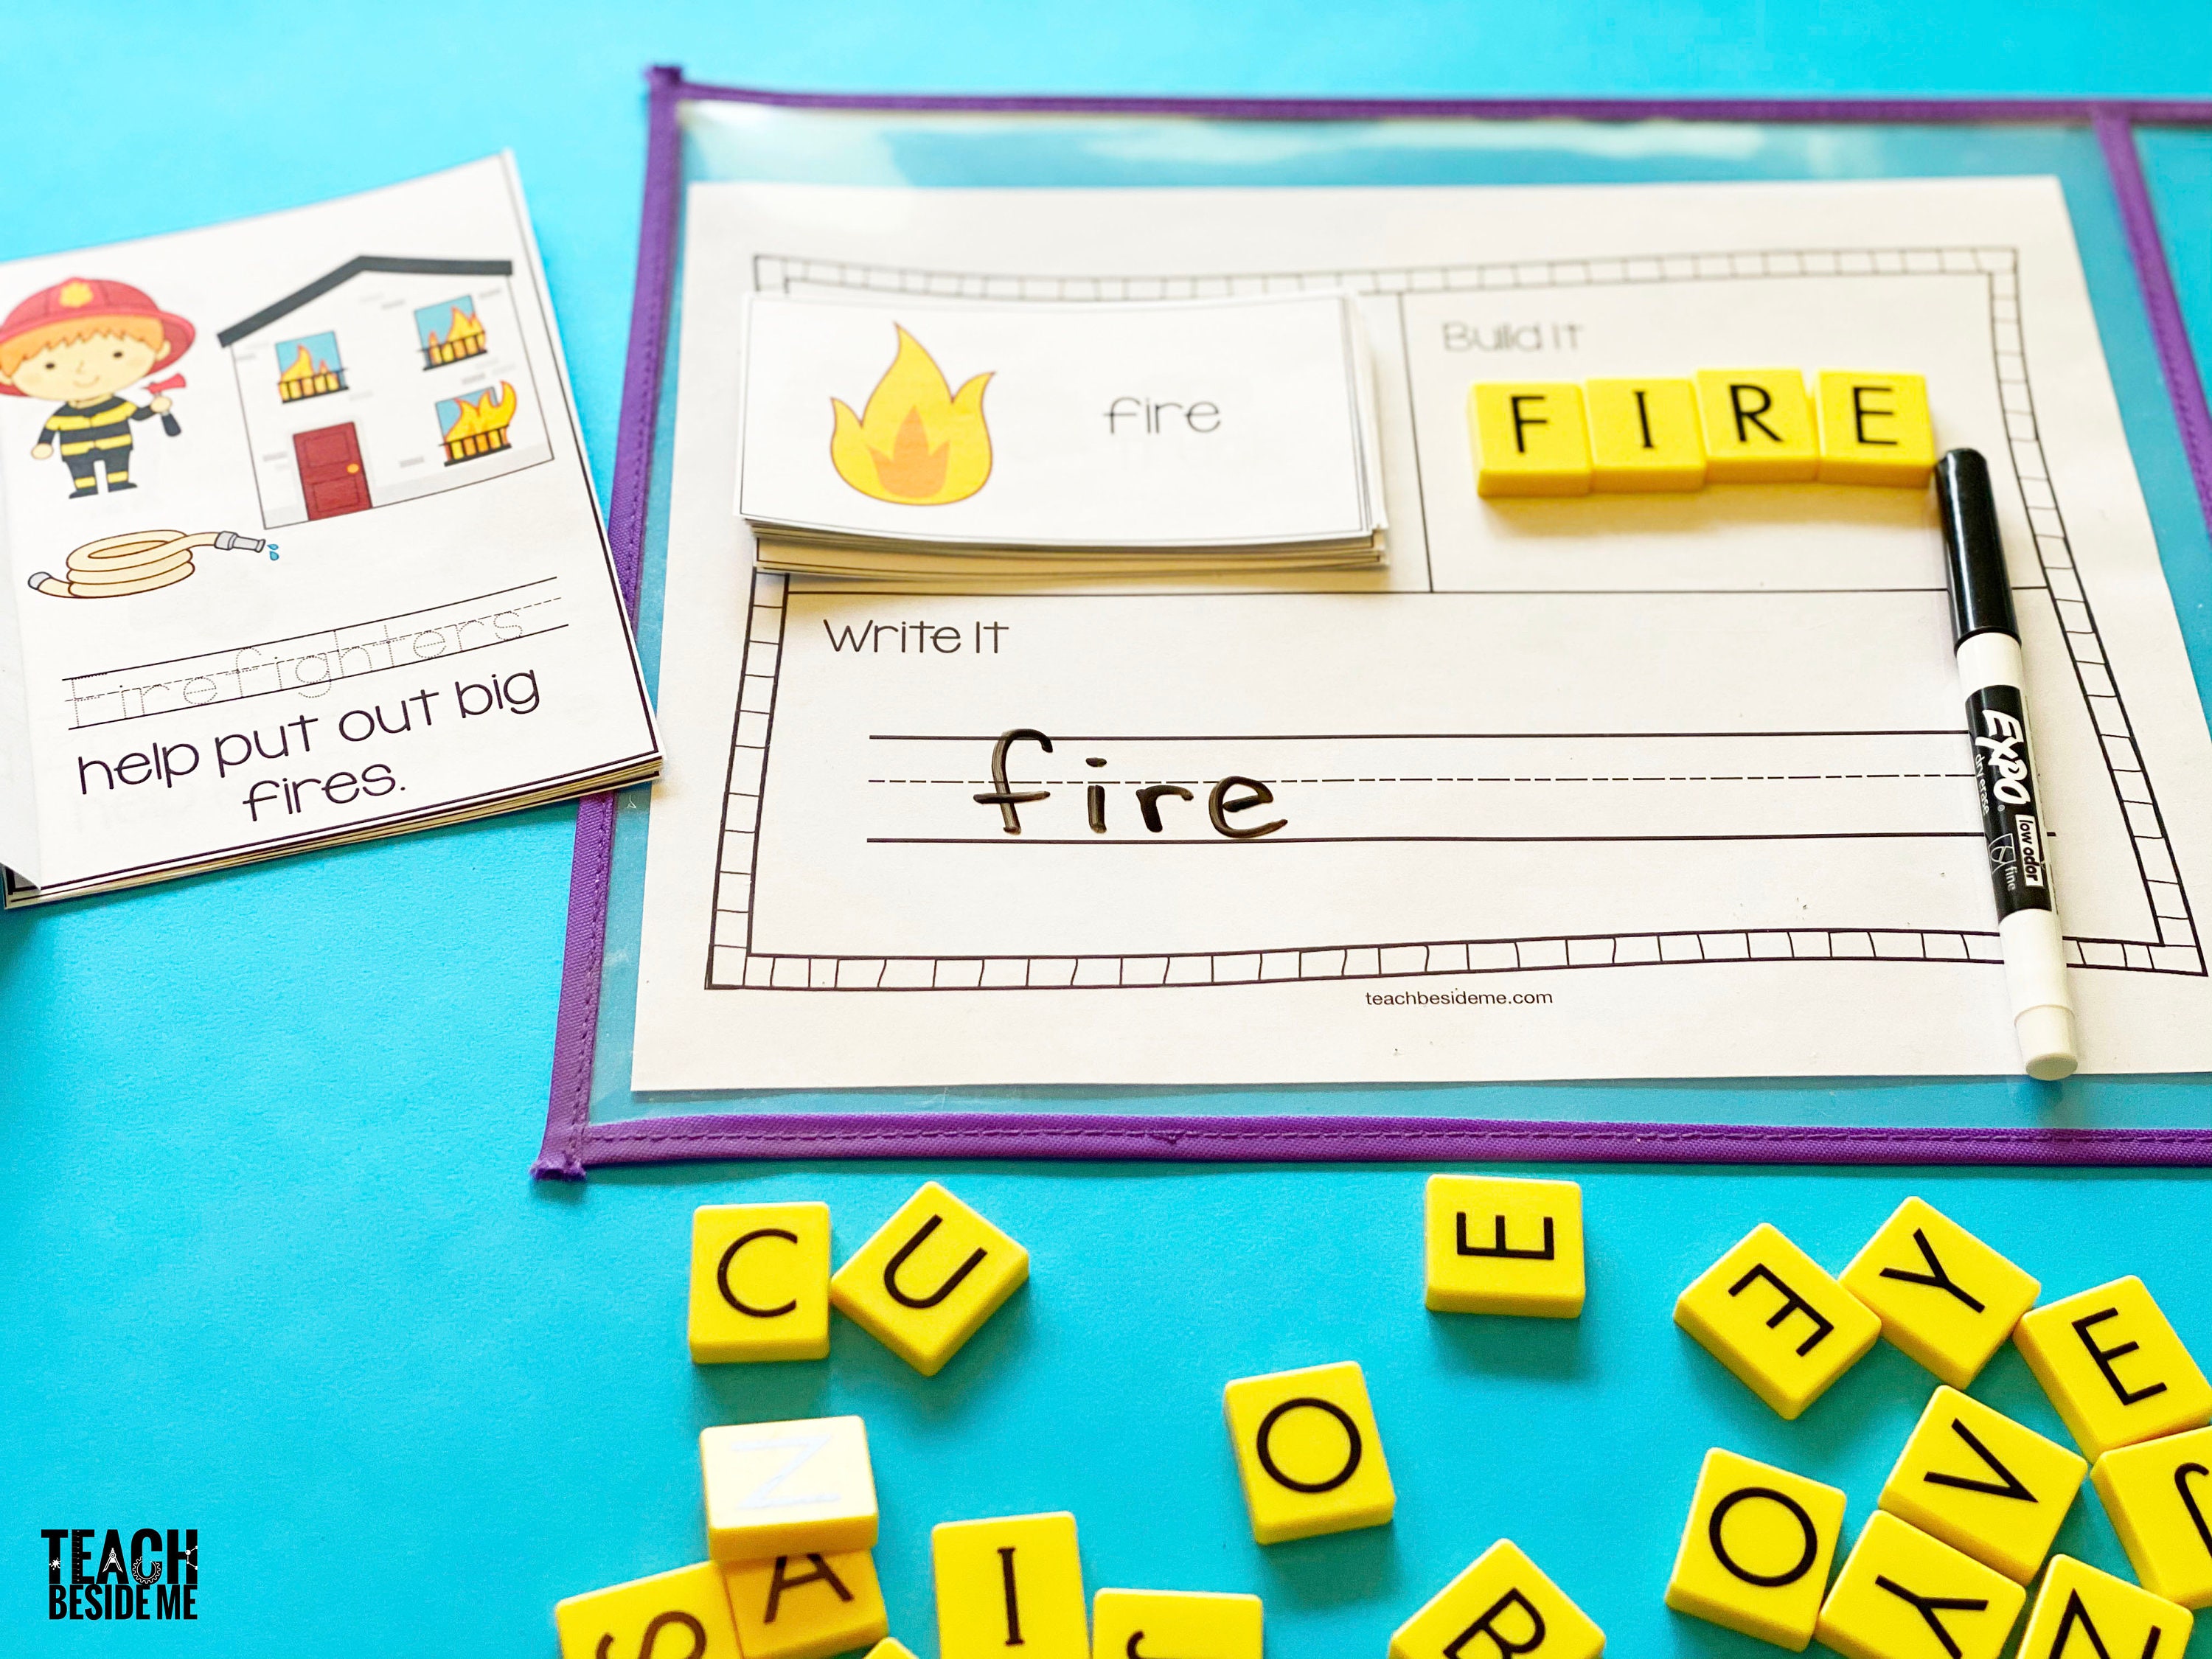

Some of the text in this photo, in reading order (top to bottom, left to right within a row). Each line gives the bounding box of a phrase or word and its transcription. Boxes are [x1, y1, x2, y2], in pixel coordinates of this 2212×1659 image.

[1441, 320, 1585, 353] Build It
[1102, 396, 1222, 435] fire
[71, 611, 524, 728] Firefighters
[823, 618, 1009, 655] Write It
[77, 668, 540, 796] help put out big
[1975, 709, 2031, 804] EXPO
[243, 762, 406, 822] fires.
[973, 727, 1289, 839] fire
[1975, 753, 1990, 815] dry erase
[2005, 864, 2018, 891] fine
[2019, 819, 2041, 882] low odor
[1365, 990, 1554, 1005] teachbesideme.com
[717, 1228, 798, 1318] C
[883, 1214, 989, 1310] U
[1455, 1210, 1555, 1262] E
[1879, 1228, 1986, 1313] Y
[1728, 1262, 1834, 1357] E
[2070, 1307, 2168, 1405] E
[1256, 1396, 1363, 1494] O
[1924, 1417, 2039, 1503] V
[1708, 1485, 1818, 1587] O
[763, 1551, 855, 1625] A
[998, 1546, 1026, 1646] I
[1875, 1573, 1989, 1659] Y
